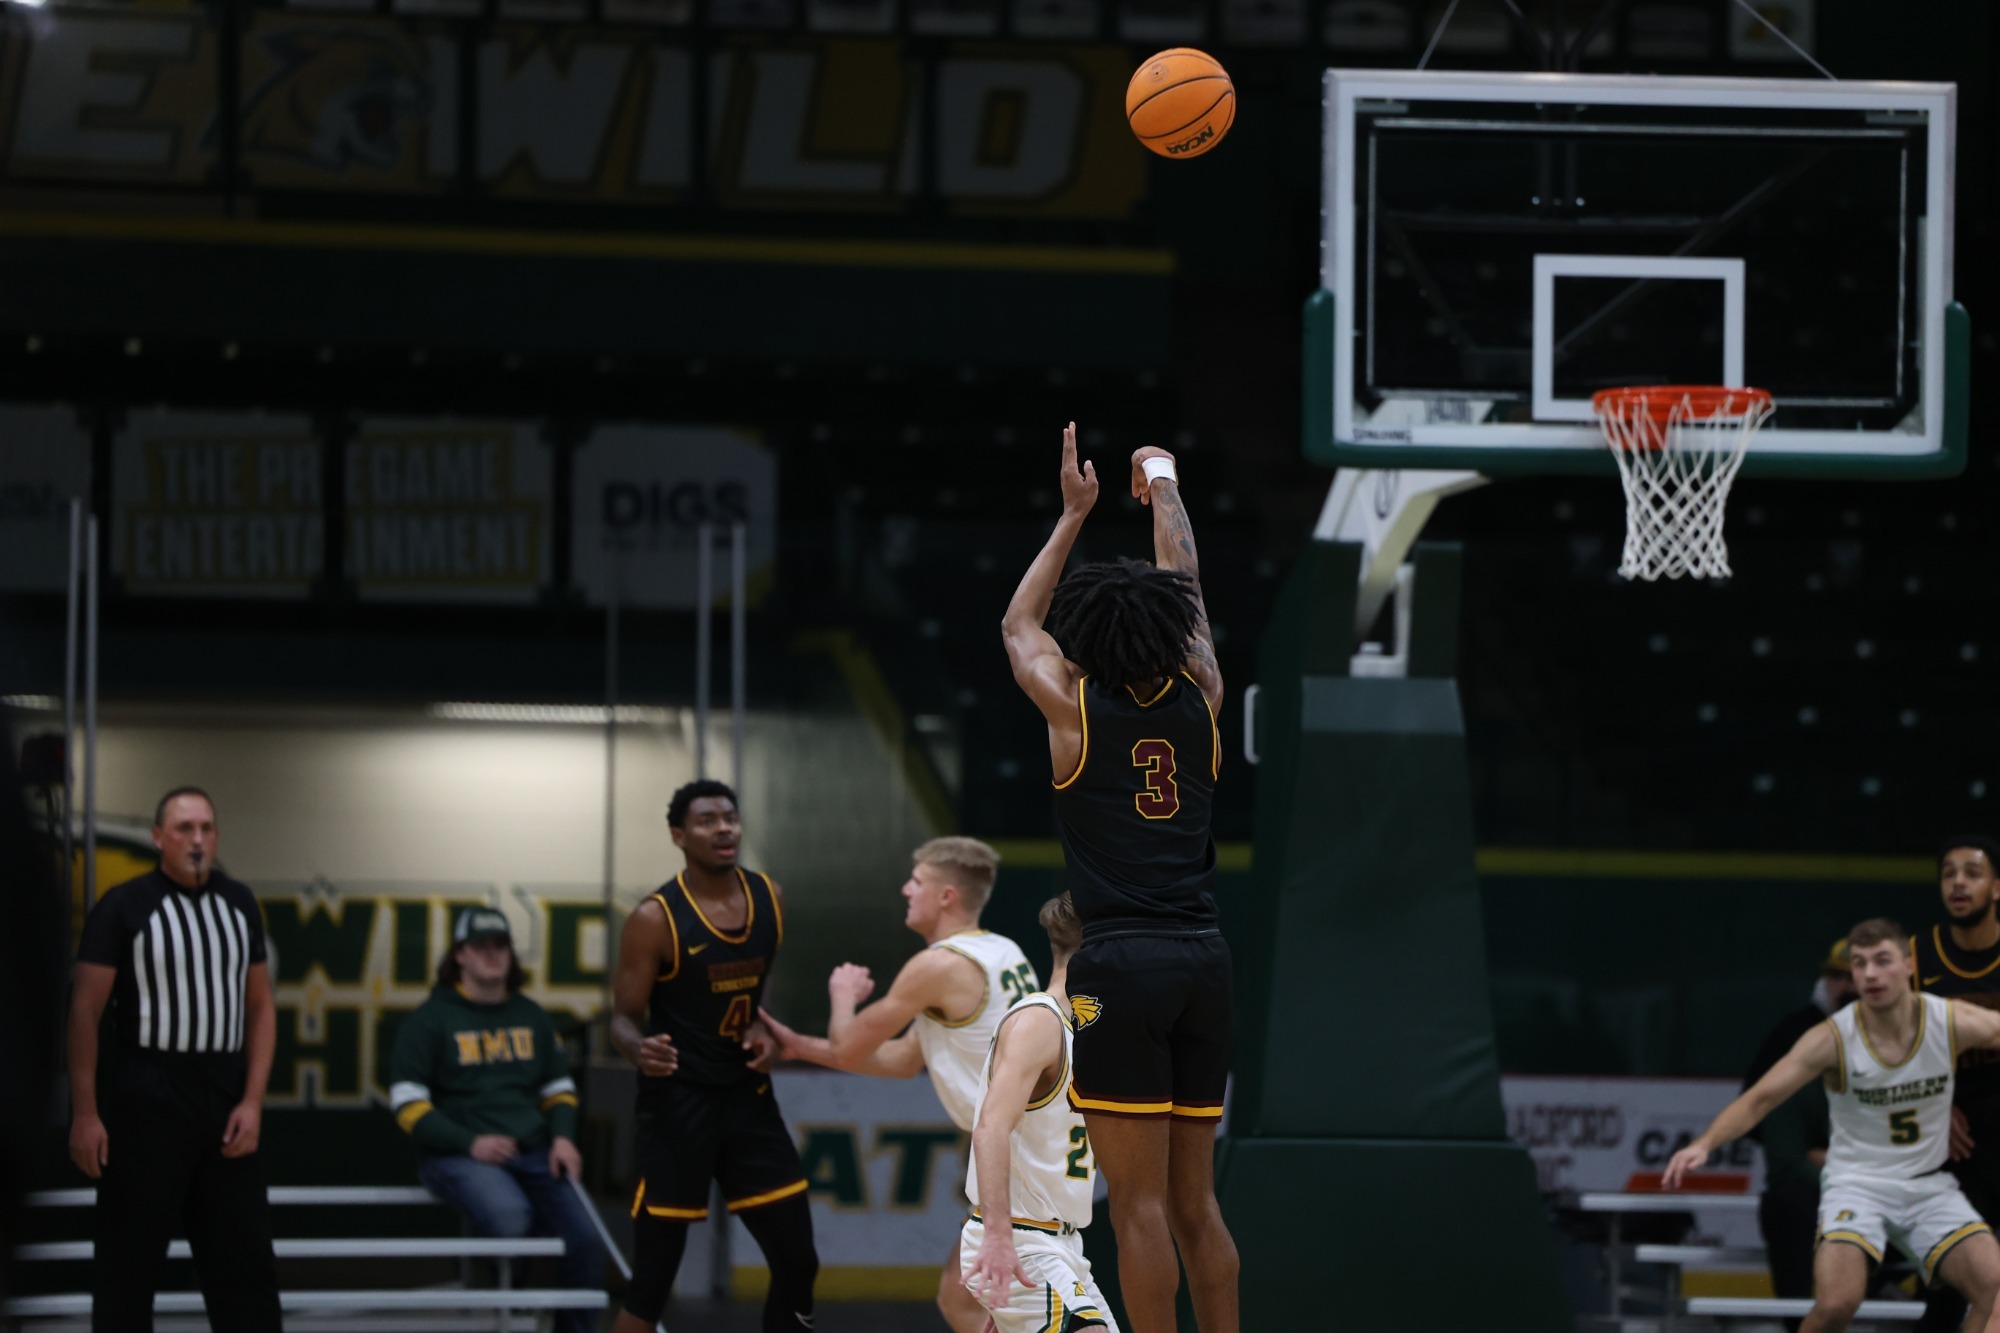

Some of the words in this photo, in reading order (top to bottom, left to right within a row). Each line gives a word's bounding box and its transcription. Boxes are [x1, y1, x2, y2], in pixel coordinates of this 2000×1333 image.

[1165, 125, 1215, 155] NCAA
[160, 444, 246, 506] THE
[603, 478, 749, 530] DIGS
[1131, 738, 1180, 820] 3
[718, 994, 752, 1043] 4
[453, 1025, 536, 1067] NMU
[1887, 1108, 1921, 1146] 5
[1065, 1123, 1097, 1182] 2
